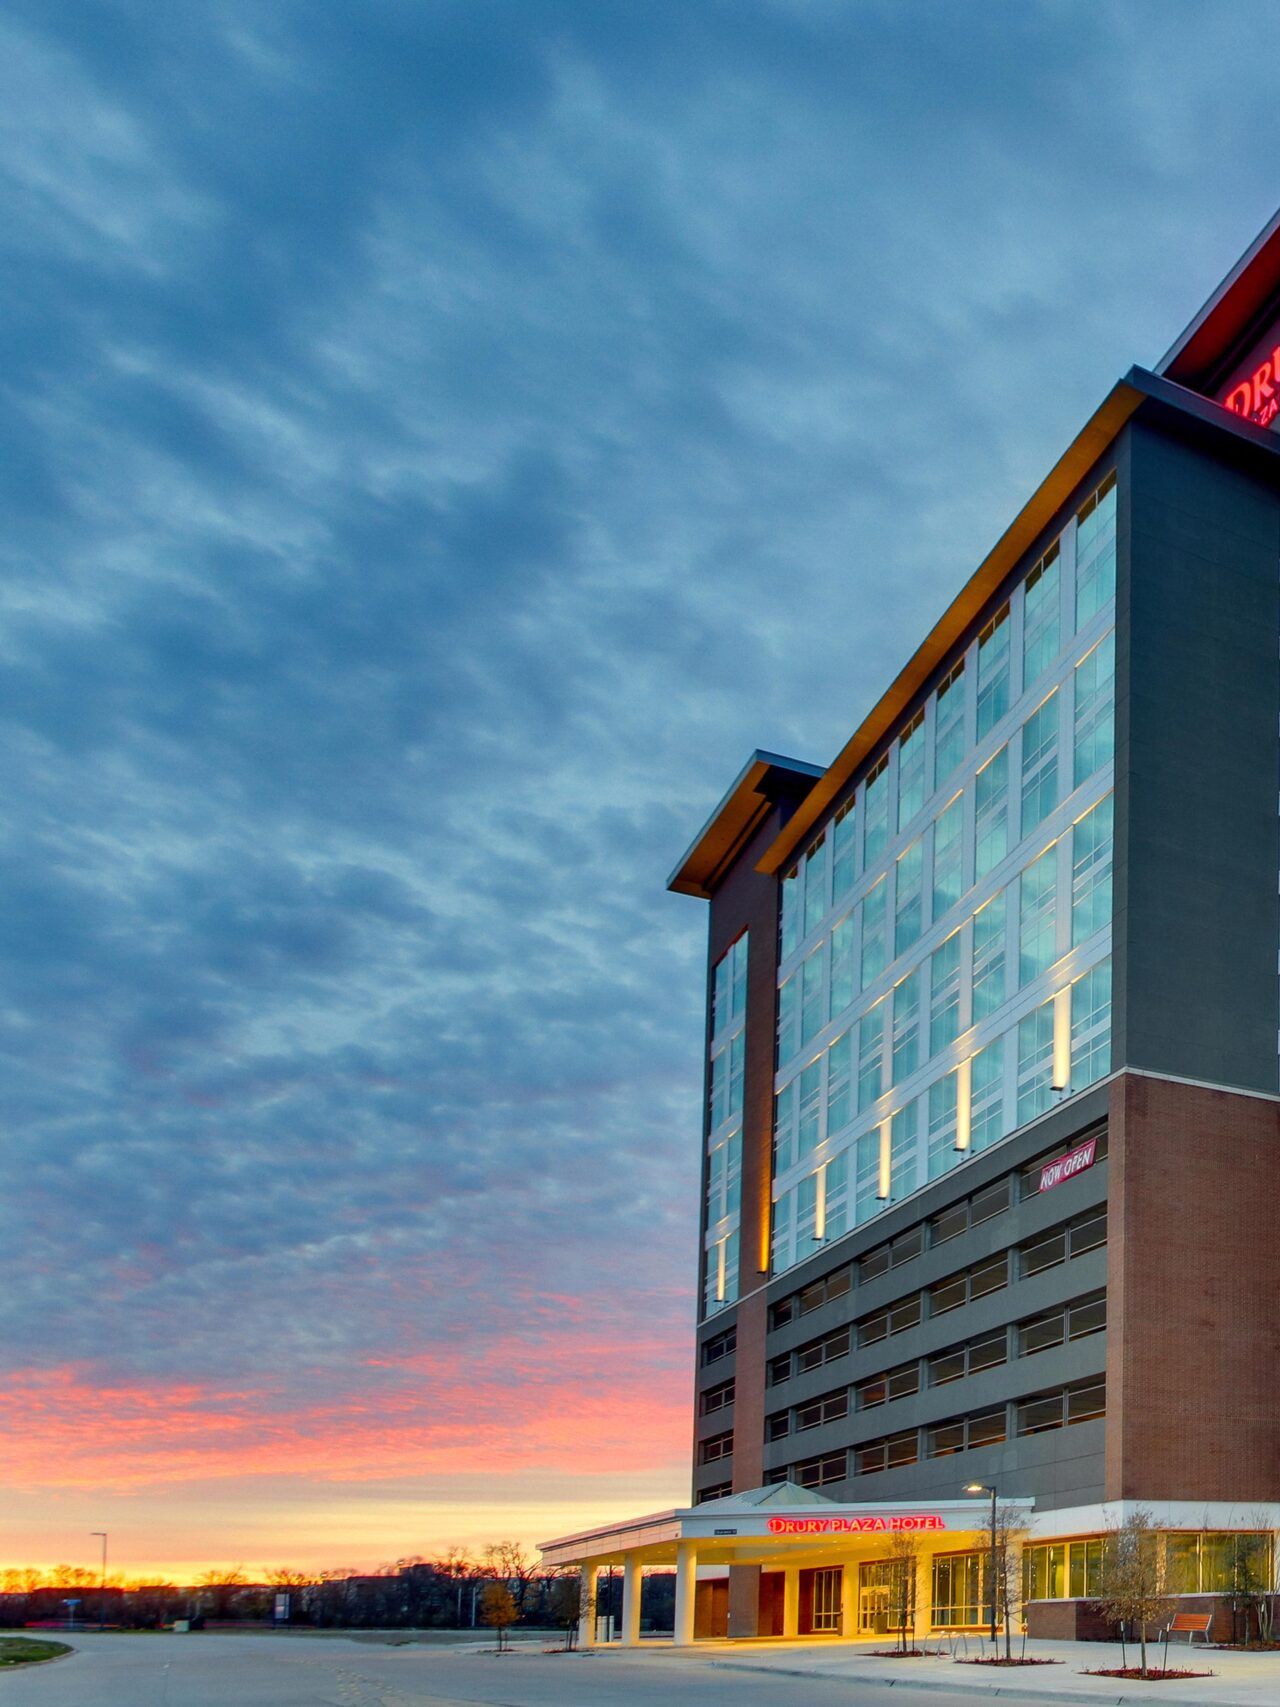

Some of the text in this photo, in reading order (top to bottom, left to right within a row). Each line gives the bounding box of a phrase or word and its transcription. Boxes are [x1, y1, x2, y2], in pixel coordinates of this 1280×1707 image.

[1040, 1147, 1092, 1189] NOW OPEN
[769, 1516, 944, 1533] DRURY PLAZA HOTEL
